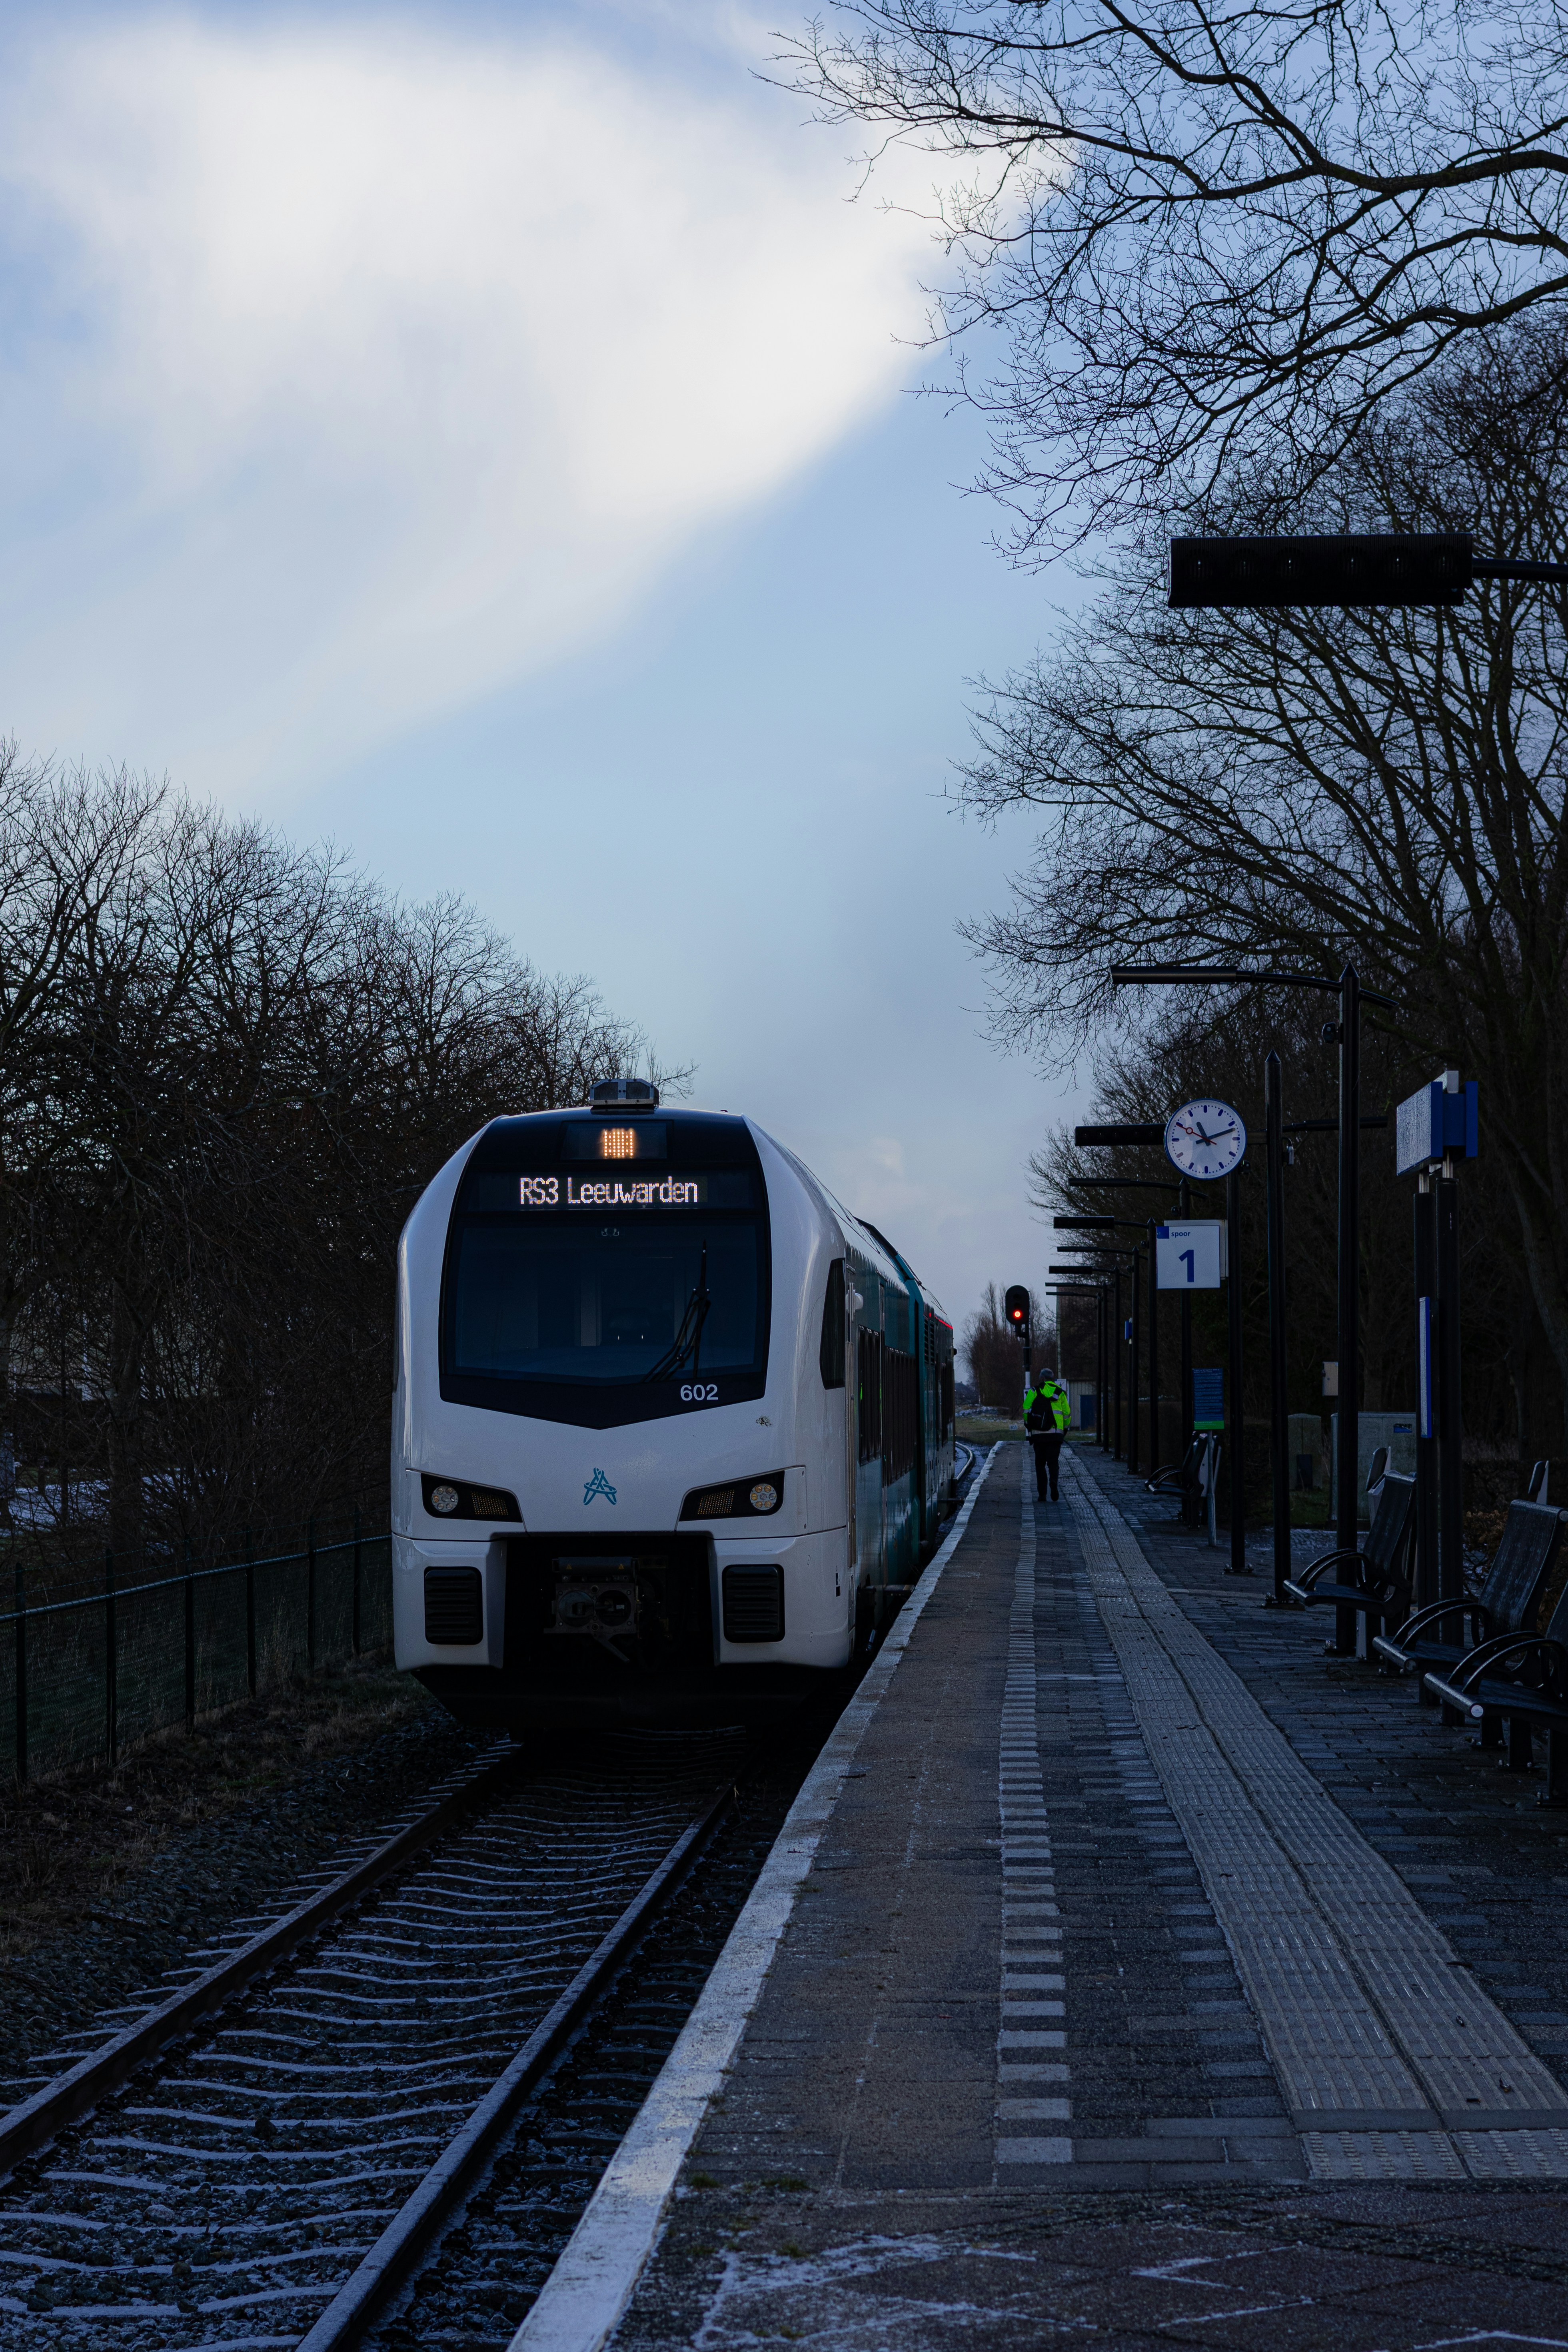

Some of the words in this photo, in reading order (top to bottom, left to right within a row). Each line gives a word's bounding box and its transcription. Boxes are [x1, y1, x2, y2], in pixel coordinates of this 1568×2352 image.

[520, 1177, 558, 1204] RS3
[568, 1176, 697, 1204] Leeuwarden
[1178, 1249, 1194, 1282] 1
[680, 1384, 718, 1401] 602
